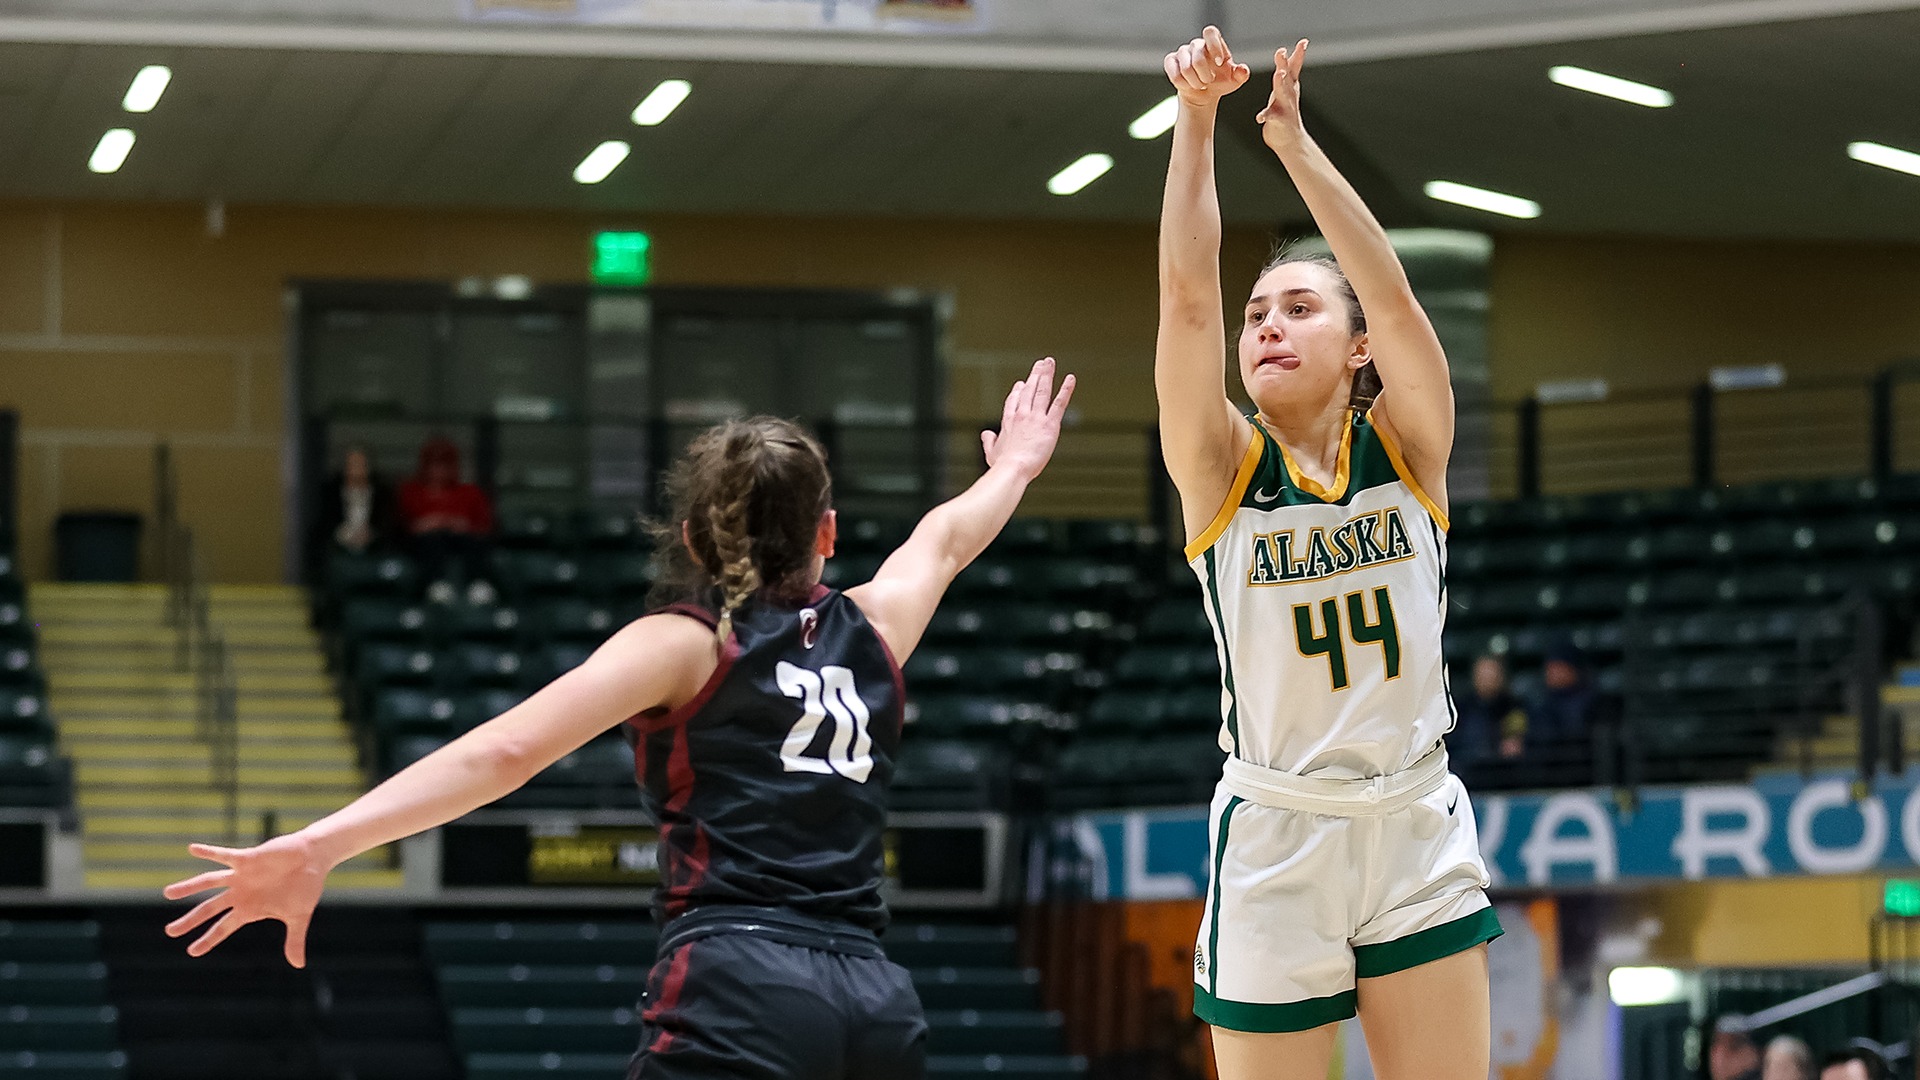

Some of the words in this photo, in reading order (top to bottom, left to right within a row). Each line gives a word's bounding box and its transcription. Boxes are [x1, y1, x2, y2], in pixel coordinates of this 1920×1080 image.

[1247, 506, 1416, 587] ALASKA
[1291, 585, 1401, 692] 44
[775, 661, 874, 783] 20
[1672, 779, 1920, 881] RO
